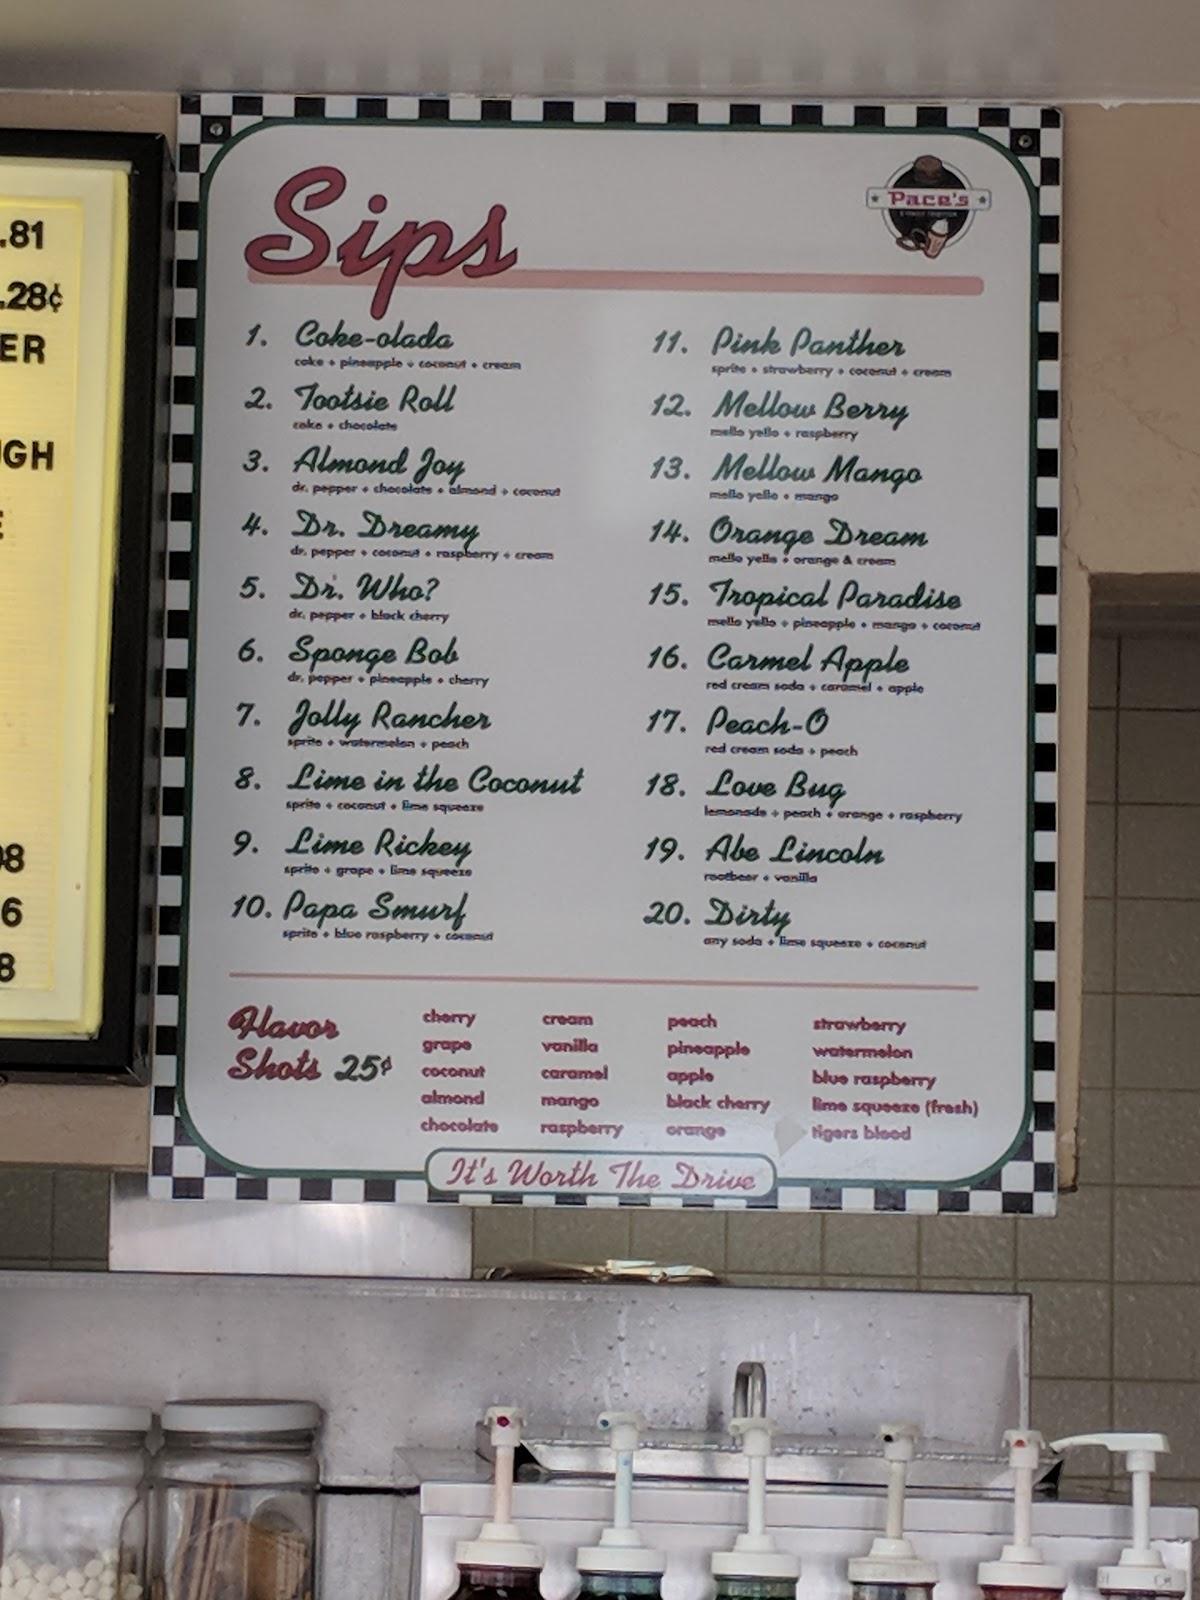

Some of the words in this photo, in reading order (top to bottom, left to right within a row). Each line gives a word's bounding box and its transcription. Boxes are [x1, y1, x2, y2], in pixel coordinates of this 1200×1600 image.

[888, 191, 969, 207] Pace's
[0, 220, 43, 249] .81
[244, 166, 518, 320] Sips
[246, 324, 267, 346] 1.
[295, 320, 453, 349] Coke-olada
[652, 330, 687, 353] 11.
[712, 326, 781, 356] Pink
[790, 327, 906, 356] Panther
[0, 333, 45, 364] ER
[340, 358, 402, 369] pineapple
[419, 360, 467, 369] coconut
[244, 388, 272, 409] 2.
[295, 383, 389, 412] Tootsie
[399, 386, 457, 412] Roll
[650, 394, 691, 416] 12.
[712, 390, 816, 418] Mellow
[823, 392, 909, 430] Berry
[339, 421, 398, 431] chocolate
[711, 427, 744, 437] mello
[749, 428, 779, 439] yello
[796, 429, 858, 441] raspberry
[0, 440, 54, 470] GH
[242, 451, 268, 472] 3.
[293, 446, 409, 474] Almond
[413, 448, 465, 484] Joy
[650, 456, 690, 480] 13.
[711, 453, 815, 482] Mellow
[822, 455, 922, 493] Mango
[292, 482, 309, 493] dr.
[313, 485, 358, 496] pepper
[373, 484, 432, 494] chocolate
[449, 485, 496, 496] almond
[513, 488, 560, 496] coconut
[710, 490, 743, 499] mello
[748, 490, 778, 501] yello
[794, 492, 838, 502] mango
[242, 513, 268, 536] 4.
[292, 510, 344, 538] Dr.
[358, 511, 480, 552] Dreamy
[649, 519, 689, 543] 14.
[709, 515, 814, 554] Orange
[824, 519, 928, 546] Dream
[239, 577, 265, 598] 5.
[290, 572, 343, 600] Dr.
[357, 574, 440, 601] Who?
[648, 583, 688, 606] 15.
[709, 578, 830, 615] Tropical
[837, 581, 961, 609] Paradise
[289, 609, 305, 619] dr.
[310, 611, 354, 622] pepper
[371, 610, 404, 621] black
[409, 611, 449, 623] cherry
[238, 638, 263, 662] 6.
[289, 635, 397, 673] Sponge
[405, 636, 459, 663] Bob
[648, 645, 687, 669] 16.
[707, 642, 813, 672] Carmel
[820, 644, 909, 682] Apple
[288, 672, 304, 682] dr.
[308, 675, 352, 685] pepper
[370, 674, 432, 686] pineapple
[449, 675, 489, 688] cherry
[706, 680, 727, 690] red
[774, 682, 804, 691] soda
[821, 682, 872, 692] caramel
[888, 684, 924, 694] apple
[236, 703, 261, 725] 7.
[288, 699, 362, 736] Jolly
[372, 701, 491, 729] Rancher
[646, 709, 686, 733] 17.
[706, 706, 829, 735] Peach-O
[288, 738, 322, 749] sprite
[339, 738, 414, 748] watermelon
[432, 739, 469, 750] peach
[705, 744, 726, 754] red
[774, 746, 803, 756] soda
[820, 746, 858, 758] peach
[235, 767, 261, 790] 8.
[288, 763, 366, 791] Lime
[374, 771, 405, 792] in
[412, 764, 459, 792] the
[468, 766, 585, 794] Coconut
[646, 773, 685, 797] 18.
[706, 769, 777, 798] Love
[785, 771, 846, 808] Bug
[704, 807, 767, 818] lemonade
[783, 808, 821, 819] peach
[838, 810, 882, 821] orange
[900, 811, 962, 824] raspberry
[233, 831, 258, 855] 9.
[285, 827, 364, 855] Lime
[375, 828, 472, 866] Rickey
[644, 837, 684, 862] 19.
[706, 833, 759, 862] Abe
[769, 836, 885, 865] Lincoln
[284, 865, 319, 876] sprite
[336, 866, 373, 876] grape
[390, 865, 416, 875] lime
[231, 895, 271, 918] 10.
[283, 890, 358, 928] Papa
[368, 891, 468, 930] Smurf
[643, 901, 690, 925] 20.
[704, 897, 791, 936] Dirty
[283, 929, 318, 940] sprite
[335, 929, 362, 938] blue
[366, 930, 428, 942] raspberry
[446, 931, 493, 941] coconut
[228, 1006, 339, 1040] Flavor
[422, 1011, 476, 1028] cherry
[542, 1014, 593, 1026] cream
[668, 1014, 718, 1031] peach
[813, 1018, 906, 1035] strawberry
[422, 1039, 471, 1052] grape
[542, 1039, 598, 1052] vanilla
[668, 1041, 751, 1058] pineapple
[813, 1044, 913, 1059] watermelon
[228, 1048, 322, 1081] Shots
[334, 1054, 392, 1082] 25¢
[422, 1066, 485, 1078] coconut
[541, 1066, 608, 1080] caramel
[667, 1068, 714, 1085] apple
[812, 1071, 848, 1085] blue
[854, 1073, 936, 1090] raspberry
[421, 1091, 485, 1105] almond
[541, 1095, 599, 1111] mango
[667, 1094, 711, 1109] black
[717, 1096, 770, 1114] cherry
[812, 1097, 848, 1112] lime
[852, 1101, 920, 1116] squeeze
[925, 1100, 979, 1118] (fresh)
[421, 1119, 498, 1133] chocolate
[541, 1121, 624, 1138] raspberry
[666, 1124, 726, 1139] orange
[812, 1126, 858, 1142] tigers
[864, 1126, 911, 1141] blood
[446, 1158, 497, 1186] It's
[508, 1159, 599, 1188] Worth
[609, 1161, 661, 1189] The
[672, 1162, 756, 1191] Drive
